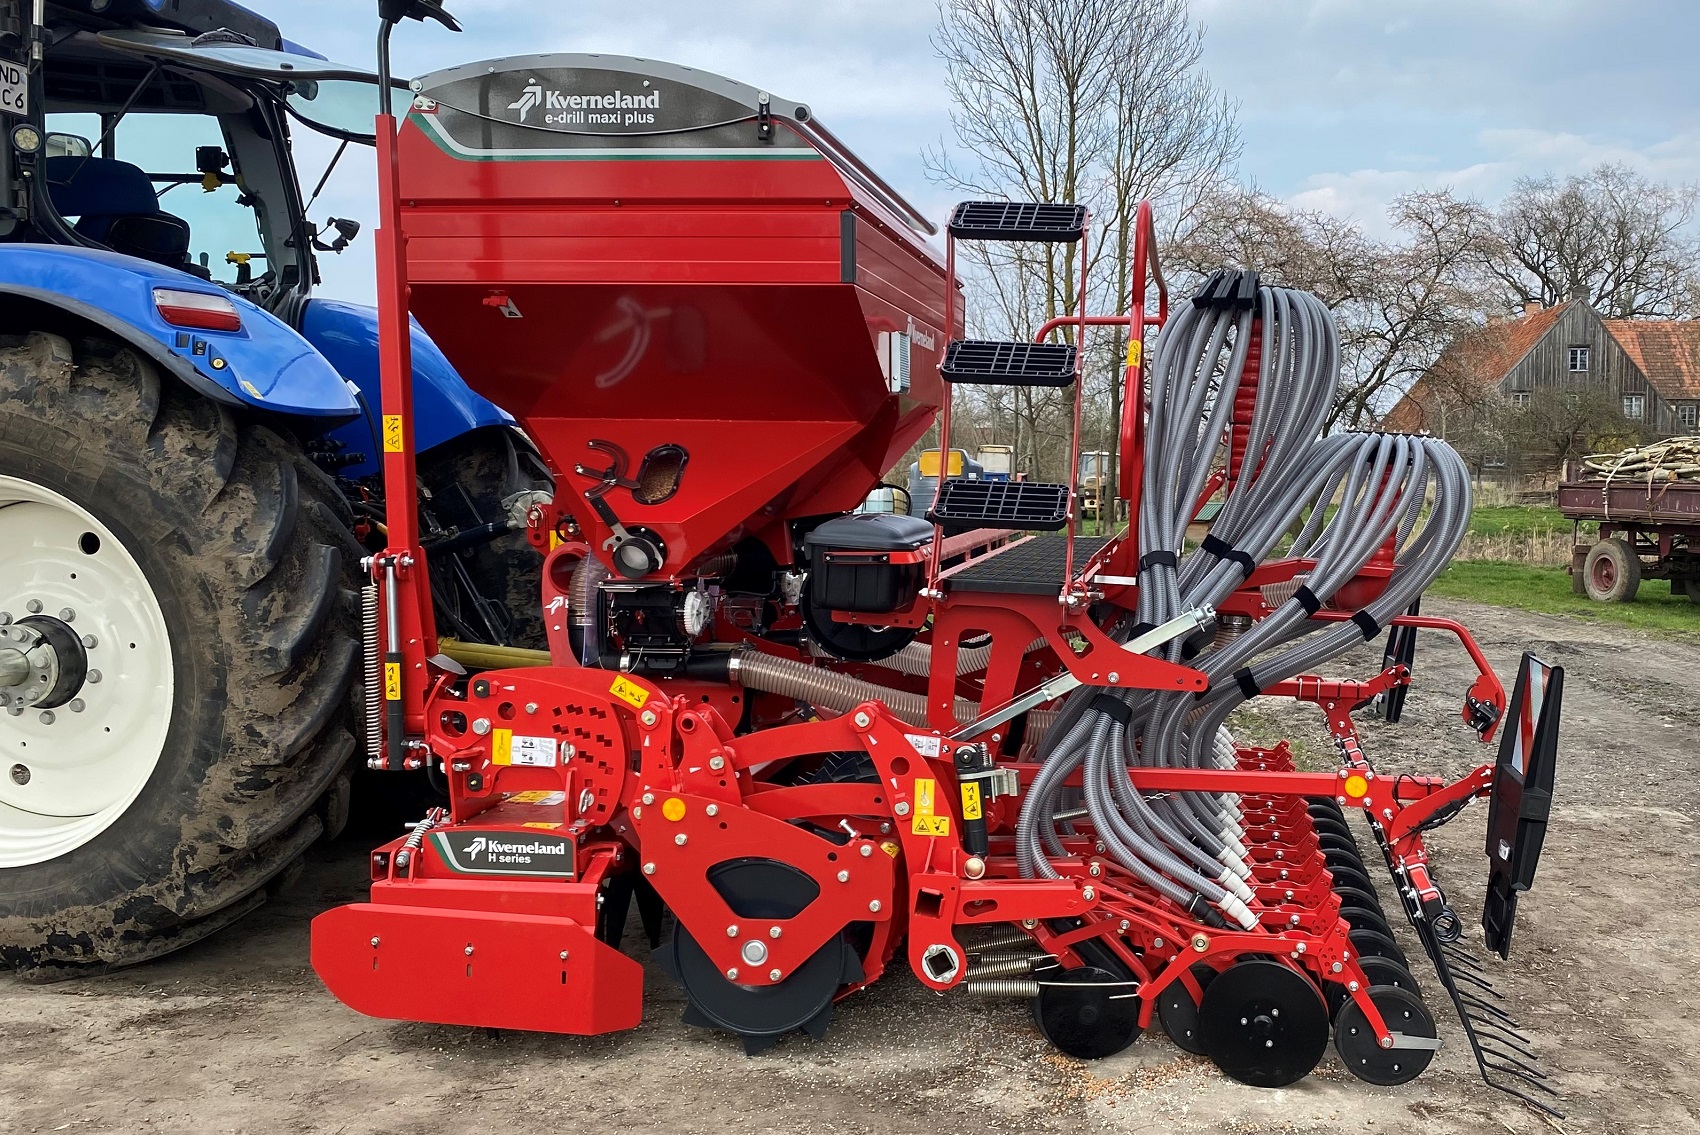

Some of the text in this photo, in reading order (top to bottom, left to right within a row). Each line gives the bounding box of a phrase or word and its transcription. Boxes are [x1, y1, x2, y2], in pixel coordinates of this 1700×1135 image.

[545, 90, 660, 109] Kverneland
[544, 111, 655, 126] e-drill maxi plus
[911, 323, 934, 351] Kverneland
[488, 840, 565, 855] Kverneland
[488, 853, 531, 864] H series
